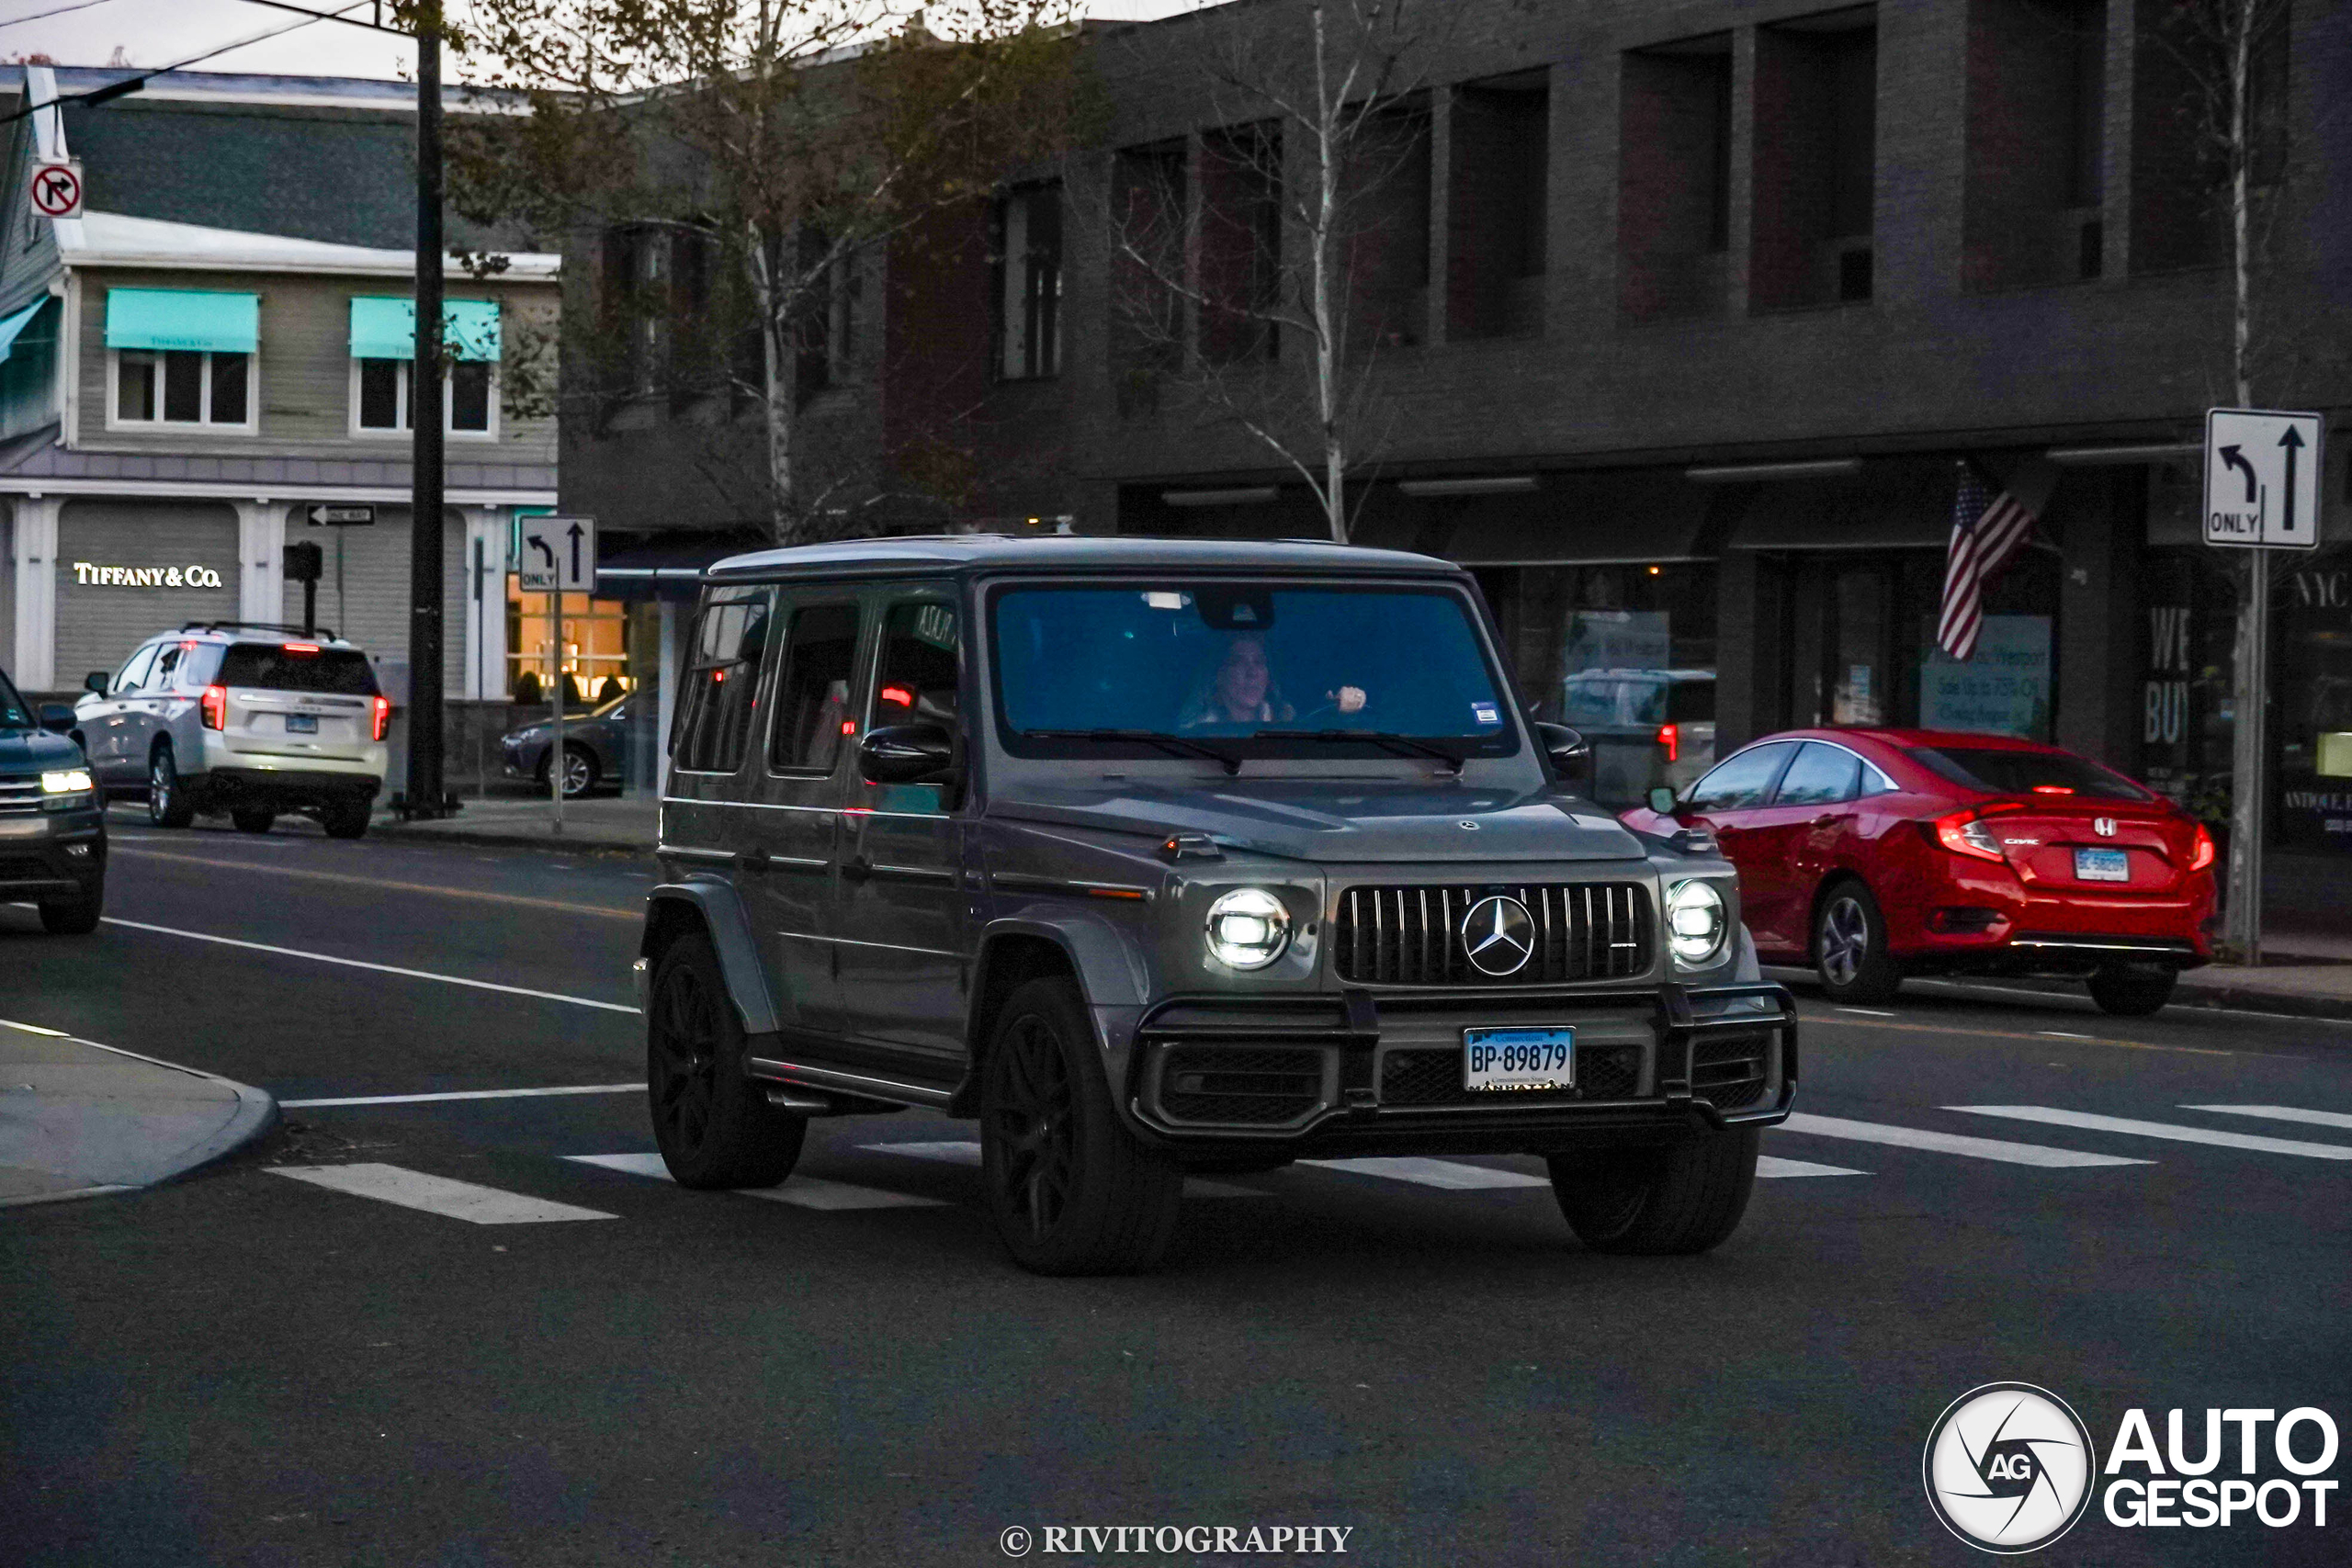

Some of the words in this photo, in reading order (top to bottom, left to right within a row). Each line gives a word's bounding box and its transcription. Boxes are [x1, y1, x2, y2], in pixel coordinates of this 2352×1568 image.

[2211, 512, 2258, 533] ONLY
[523, 574, 555, 586] ONLY
[2296, 571, 2347, 608] NYC
[2151, 607, 2190, 671] WE
